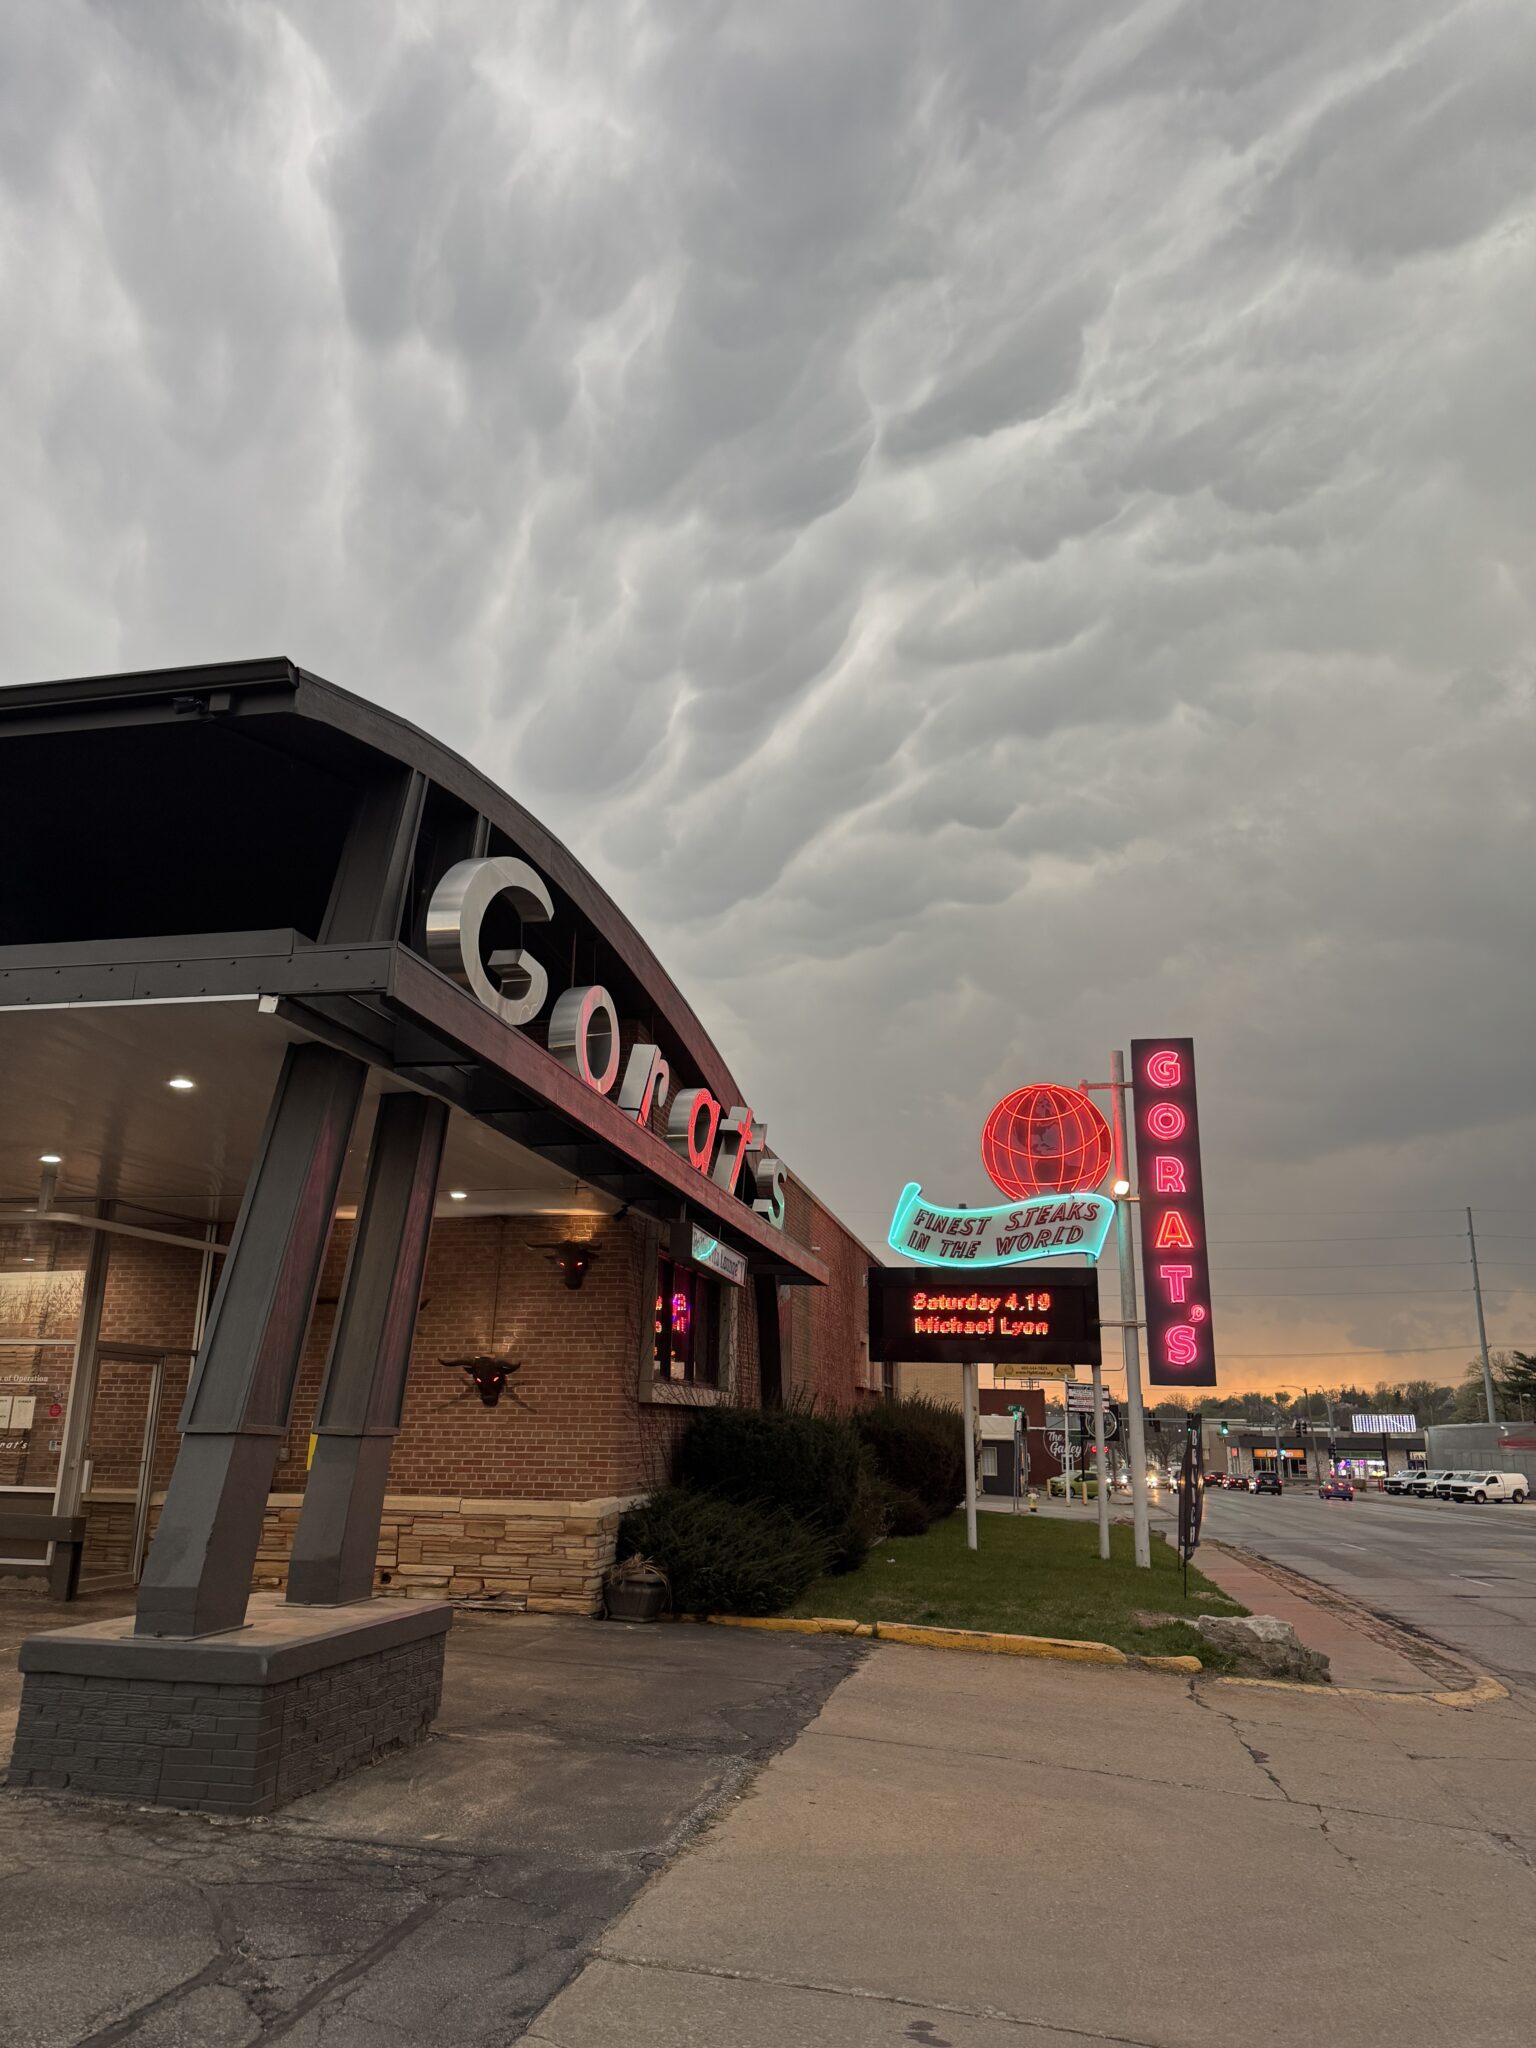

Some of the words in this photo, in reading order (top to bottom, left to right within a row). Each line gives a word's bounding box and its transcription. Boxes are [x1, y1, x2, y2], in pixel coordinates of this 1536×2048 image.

[1147, 1050, 1206, 1366] GORAT'S
[914, 1209, 992, 1235] FINEST
[1005, 1203, 1100, 1231] STEAKS
[907, 1230, 931, 1252] IN
[939, 1240, 981, 1259] THE
[995, 1226, 1084, 1257] WORLD
[913, 1292, 1001, 1314] Saturday
[914, 1316, 994, 1334] Michael
[1000, 1316, 1049, 1336] Lyon
[13, 1374, 49, 1383] Operation
[1047, 1431, 1065, 1442] The
[1050, 1441, 1082, 1457] Galey
